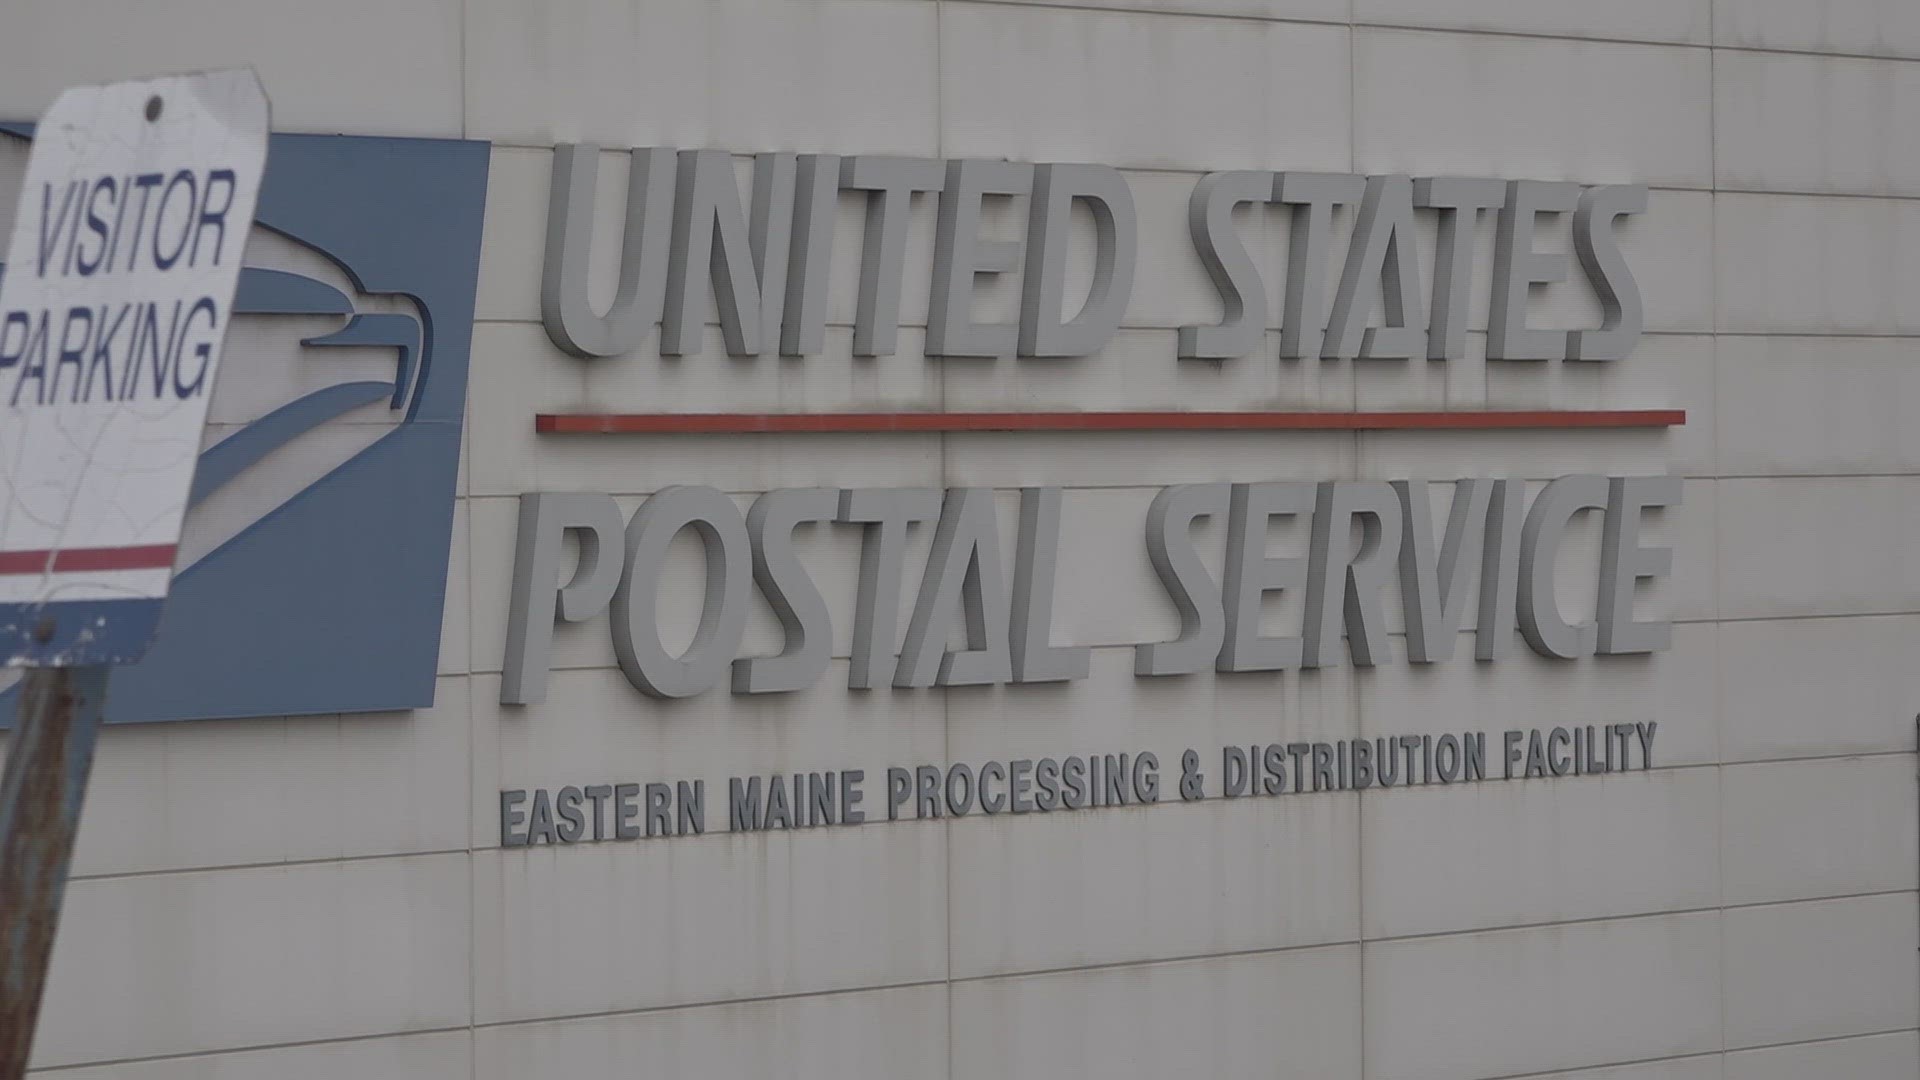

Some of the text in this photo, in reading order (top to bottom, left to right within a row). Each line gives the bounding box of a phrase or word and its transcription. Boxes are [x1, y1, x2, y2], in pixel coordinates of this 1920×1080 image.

[37, 167, 237, 278] VISITOR
[540, 143, 1649, 362] UNITED STATES
[0, 297, 216, 407] PARKING
[500, 474, 1684, 705] POSTAL SERVICE
[500, 721, 1657, 848] EASTERN MAINE PROCESSING & DISTRIBUTION FACILITY
